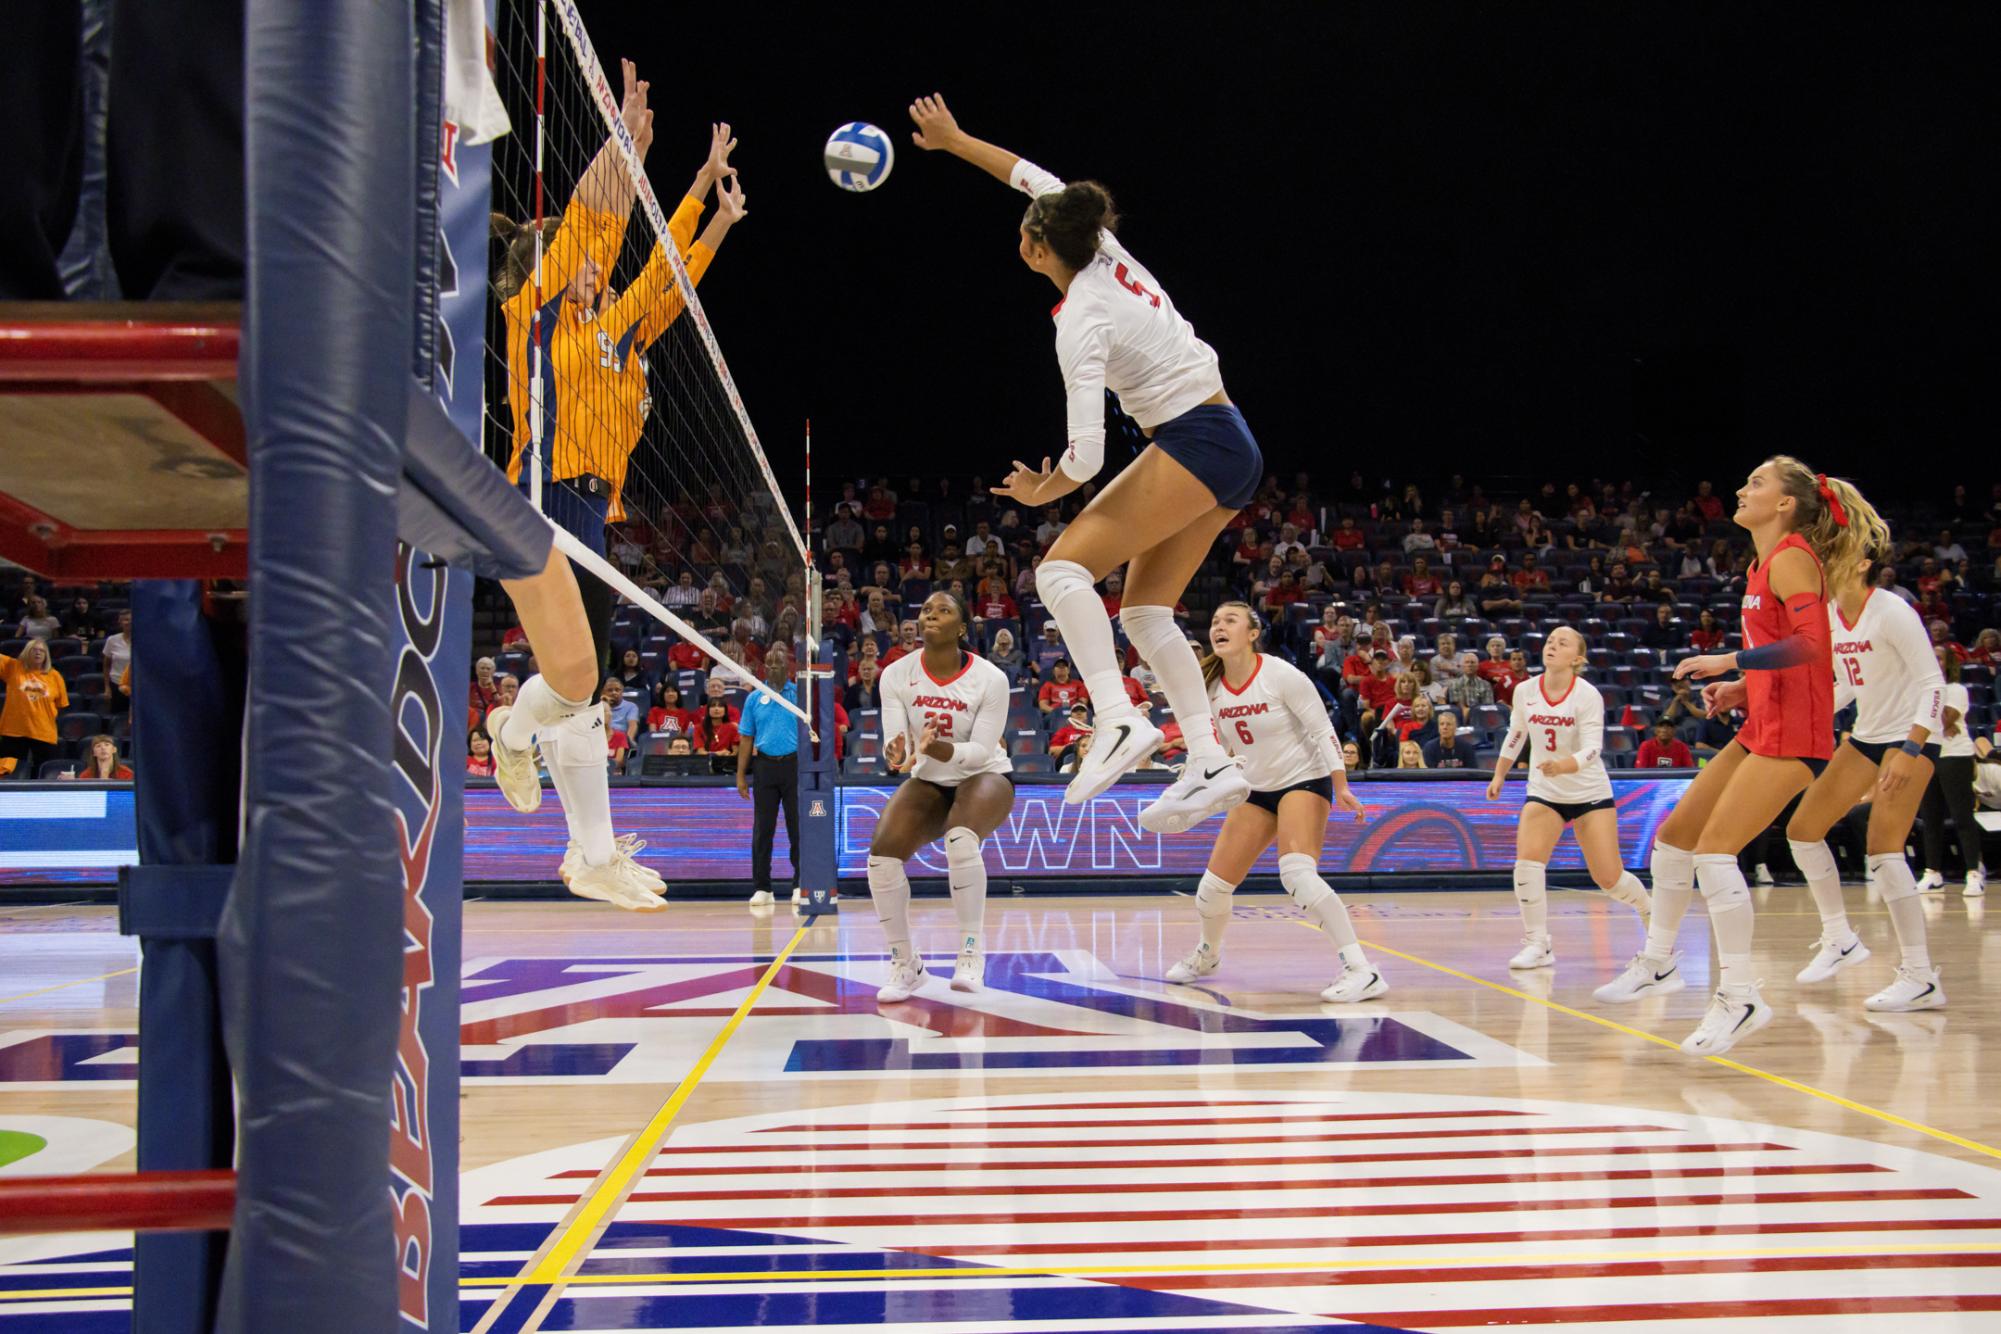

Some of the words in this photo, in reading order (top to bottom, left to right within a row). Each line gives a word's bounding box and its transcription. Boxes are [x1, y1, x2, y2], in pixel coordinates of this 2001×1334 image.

[1114, 261, 1161, 310] 5
[1843, 656, 1865, 687] 12
[911, 695, 968, 712] ARIZONA
[1218, 702, 1270, 719] ARIZONA
[660, 715, 681, 731] A
[1528, 714, 1575, 728] ARIZONA
[1234, 720, 1255, 746] 6
[1544, 728, 1557, 753] 3
[809, 799, 827, 817] A
